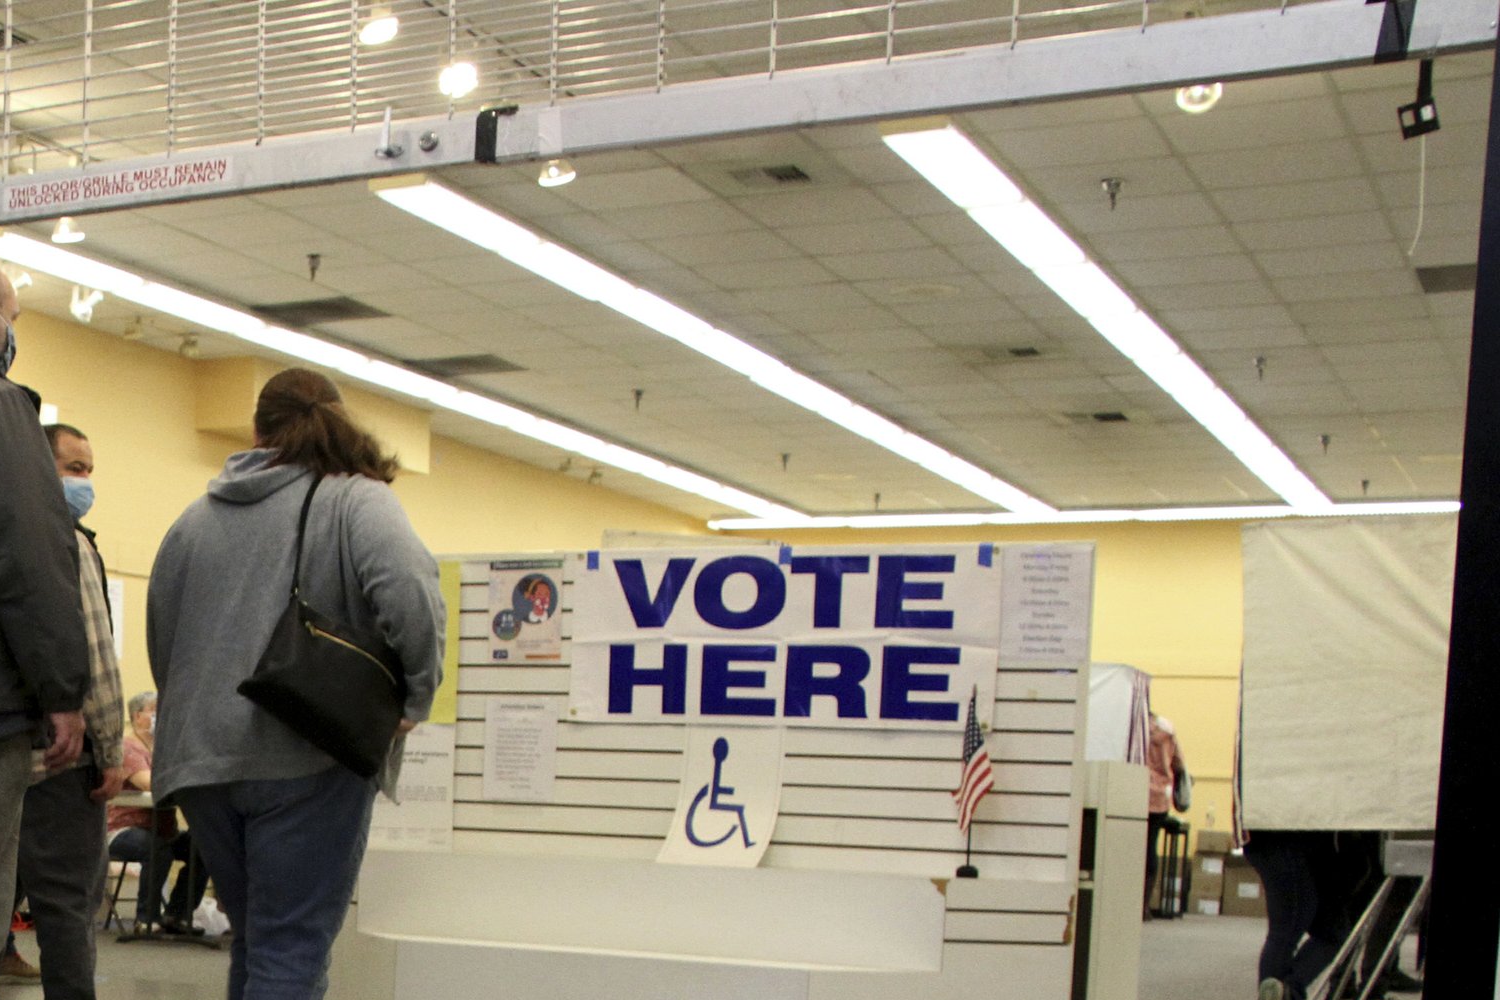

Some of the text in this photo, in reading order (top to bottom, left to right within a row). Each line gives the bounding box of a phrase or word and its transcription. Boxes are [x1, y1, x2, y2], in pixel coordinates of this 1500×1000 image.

[9, 167, 226, 209] UNLOCKED DURING OCCUPANCY
[10, 159, 227, 199] THIS DOOR/GRILLE MUST REMAIN
[612, 555, 957, 629] VOTE
[608, 644, 961, 721] HERE
